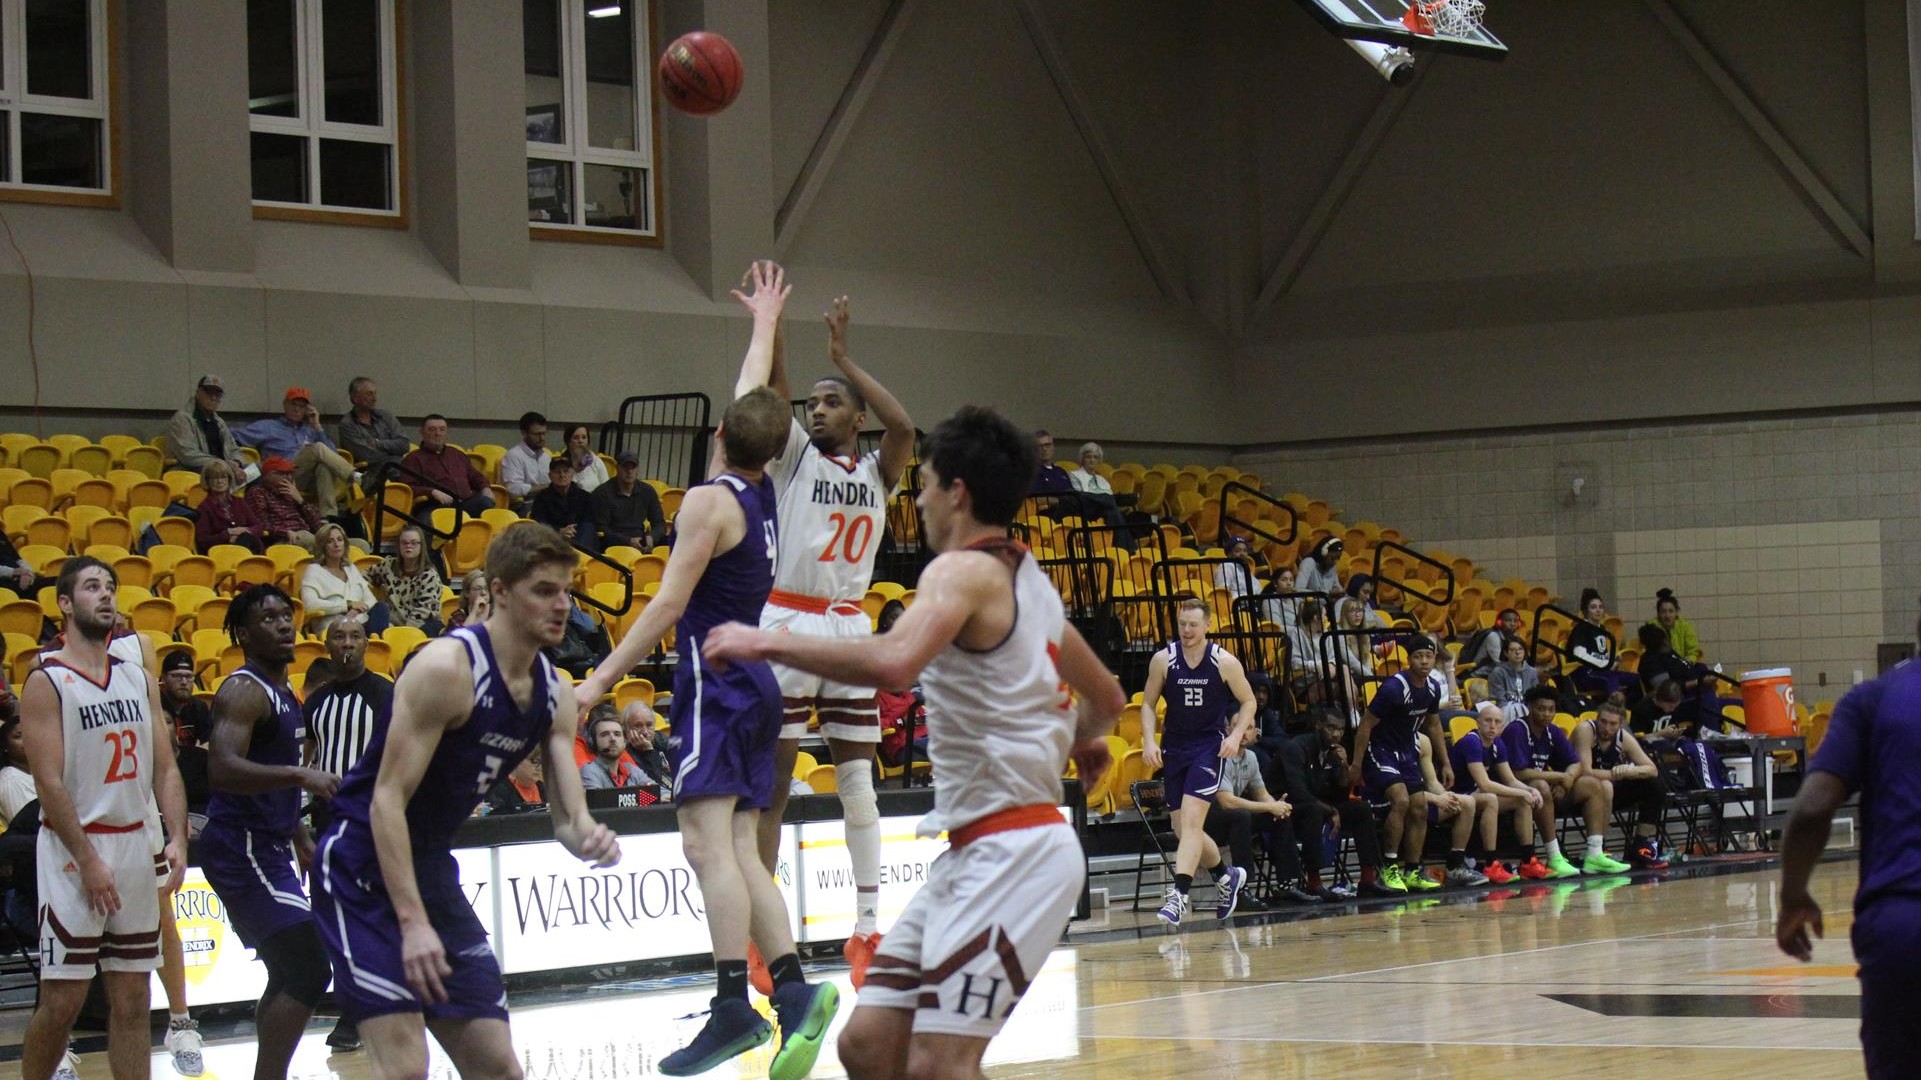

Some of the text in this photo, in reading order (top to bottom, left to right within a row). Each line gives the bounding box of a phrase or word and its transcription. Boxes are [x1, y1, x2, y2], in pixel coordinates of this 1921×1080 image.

[811, 479, 878, 509] HENDRI
[817, 512, 873, 564] 20
[1184, 687, 1204, 706] 23
[103, 729, 138, 784] 23
[479, 732, 529, 753] OZAR
[477, 754, 503, 795] 2
[618, 793, 638, 807] POSS.
[508, 868, 706, 935] WARRIOR
[40, 937, 56, 967] H
[184, 940, 214, 952] ENDRIX
[954, 973, 1002, 1019] H
